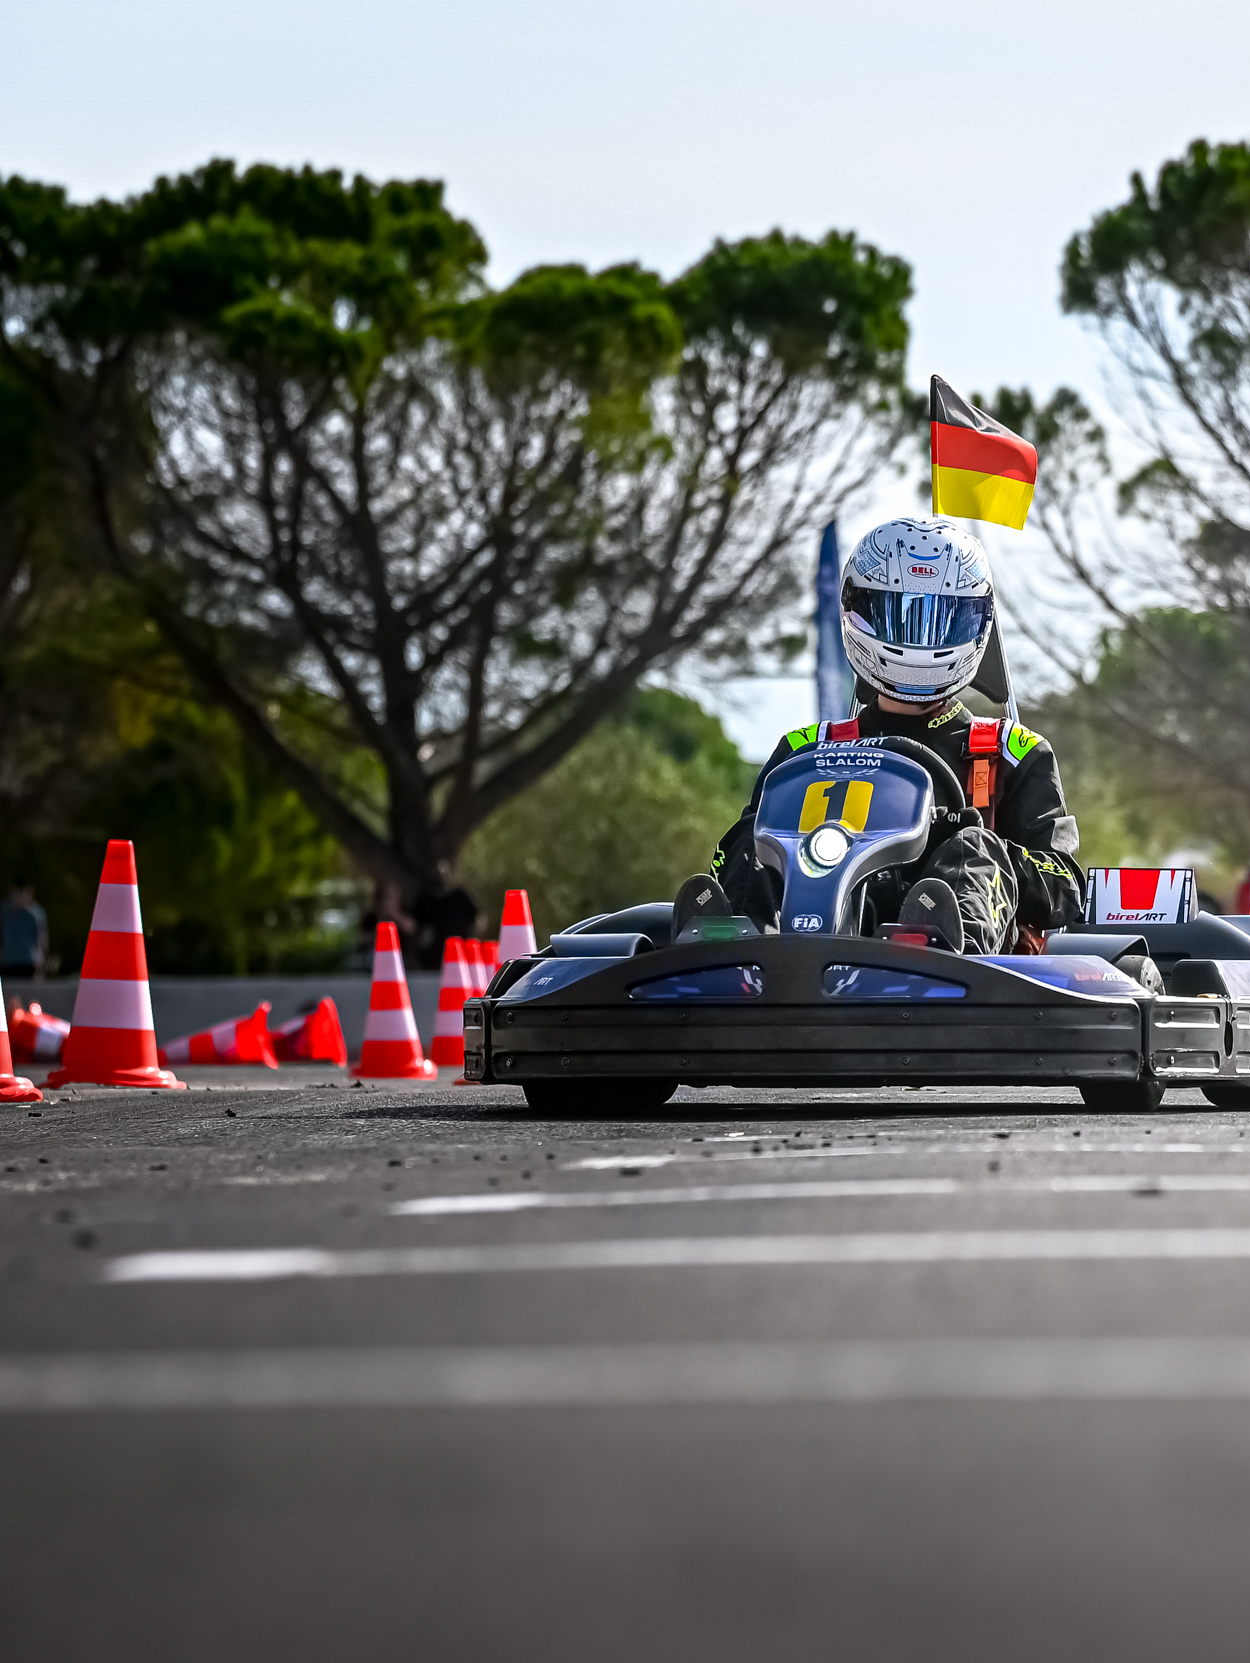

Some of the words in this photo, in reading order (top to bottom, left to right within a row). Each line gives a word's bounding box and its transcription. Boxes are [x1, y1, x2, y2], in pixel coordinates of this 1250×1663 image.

[911, 566, 936, 575] BELL
[815, 758, 881, 767] SLALOM
[822, 780, 850, 822] 1
[1106, 912, 1167, 921] birelART
